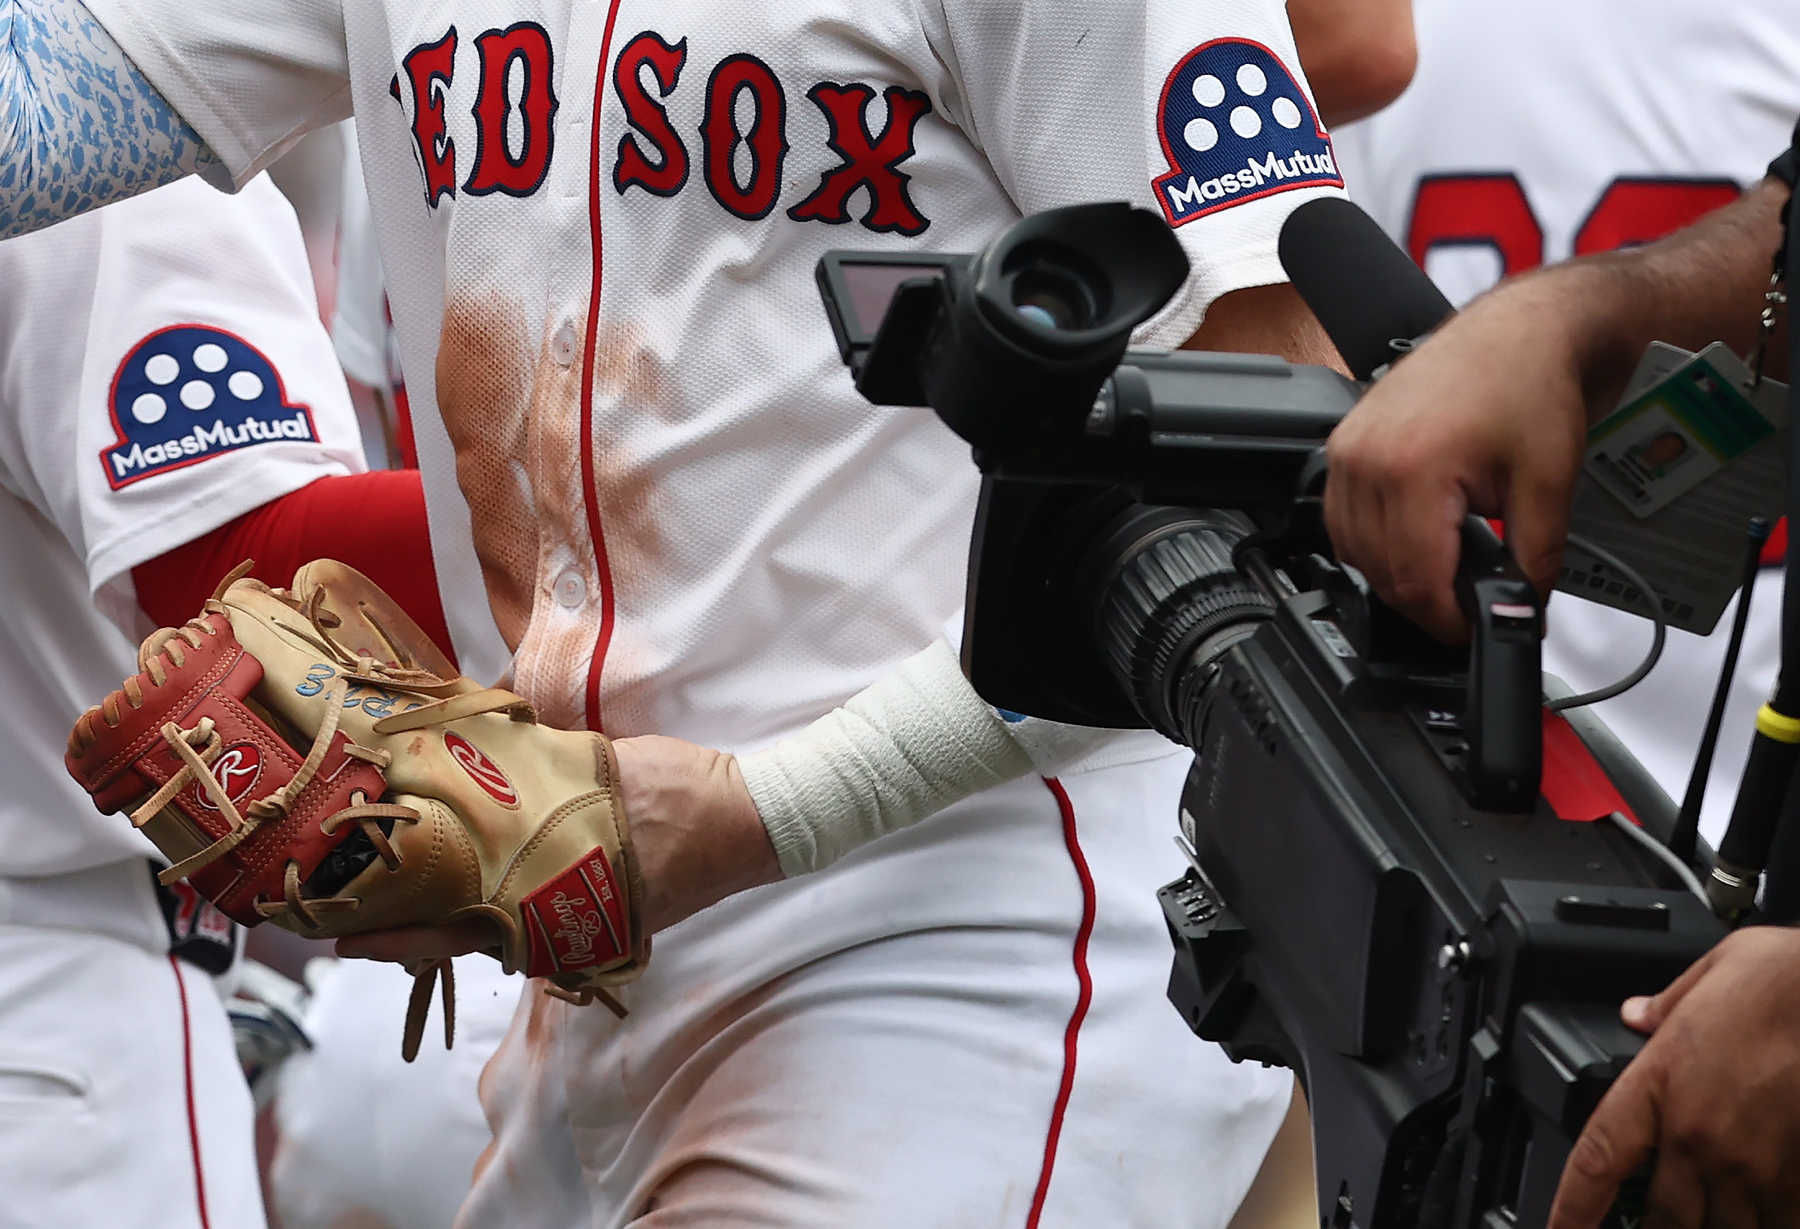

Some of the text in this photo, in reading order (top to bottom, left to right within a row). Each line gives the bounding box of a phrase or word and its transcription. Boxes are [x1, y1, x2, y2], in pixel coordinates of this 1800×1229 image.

[390, 21, 932, 237] ED SOX
[1167, 145, 1337, 213] MassMutual
[111, 411, 311, 477] MassMutual
[550, 891, 596, 965] Rawlings
